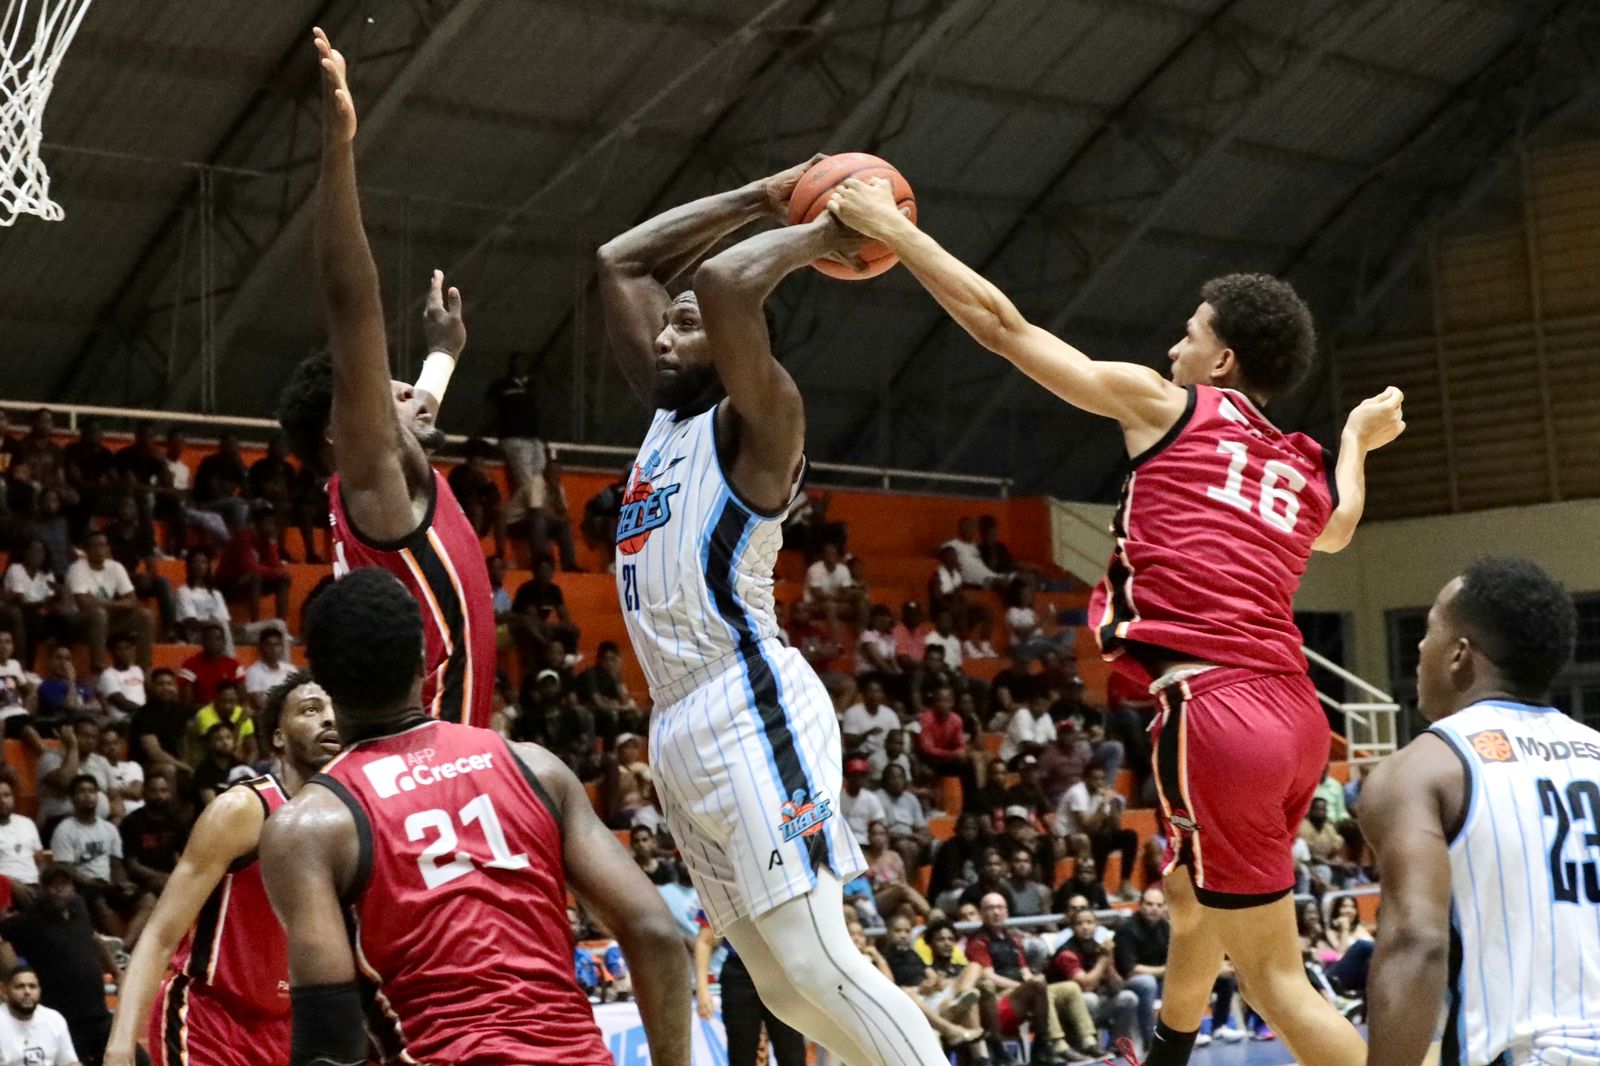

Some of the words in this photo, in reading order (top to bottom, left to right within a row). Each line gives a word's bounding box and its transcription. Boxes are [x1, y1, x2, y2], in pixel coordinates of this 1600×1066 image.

[1207, 440, 1307, 533] 16
[622, 564, 640, 611] 21
[407, 748, 436, 766] AFP
[412, 752, 494, 785] Crecer
[404, 793, 531, 890] 21
[1537, 778, 1600, 904] 23
